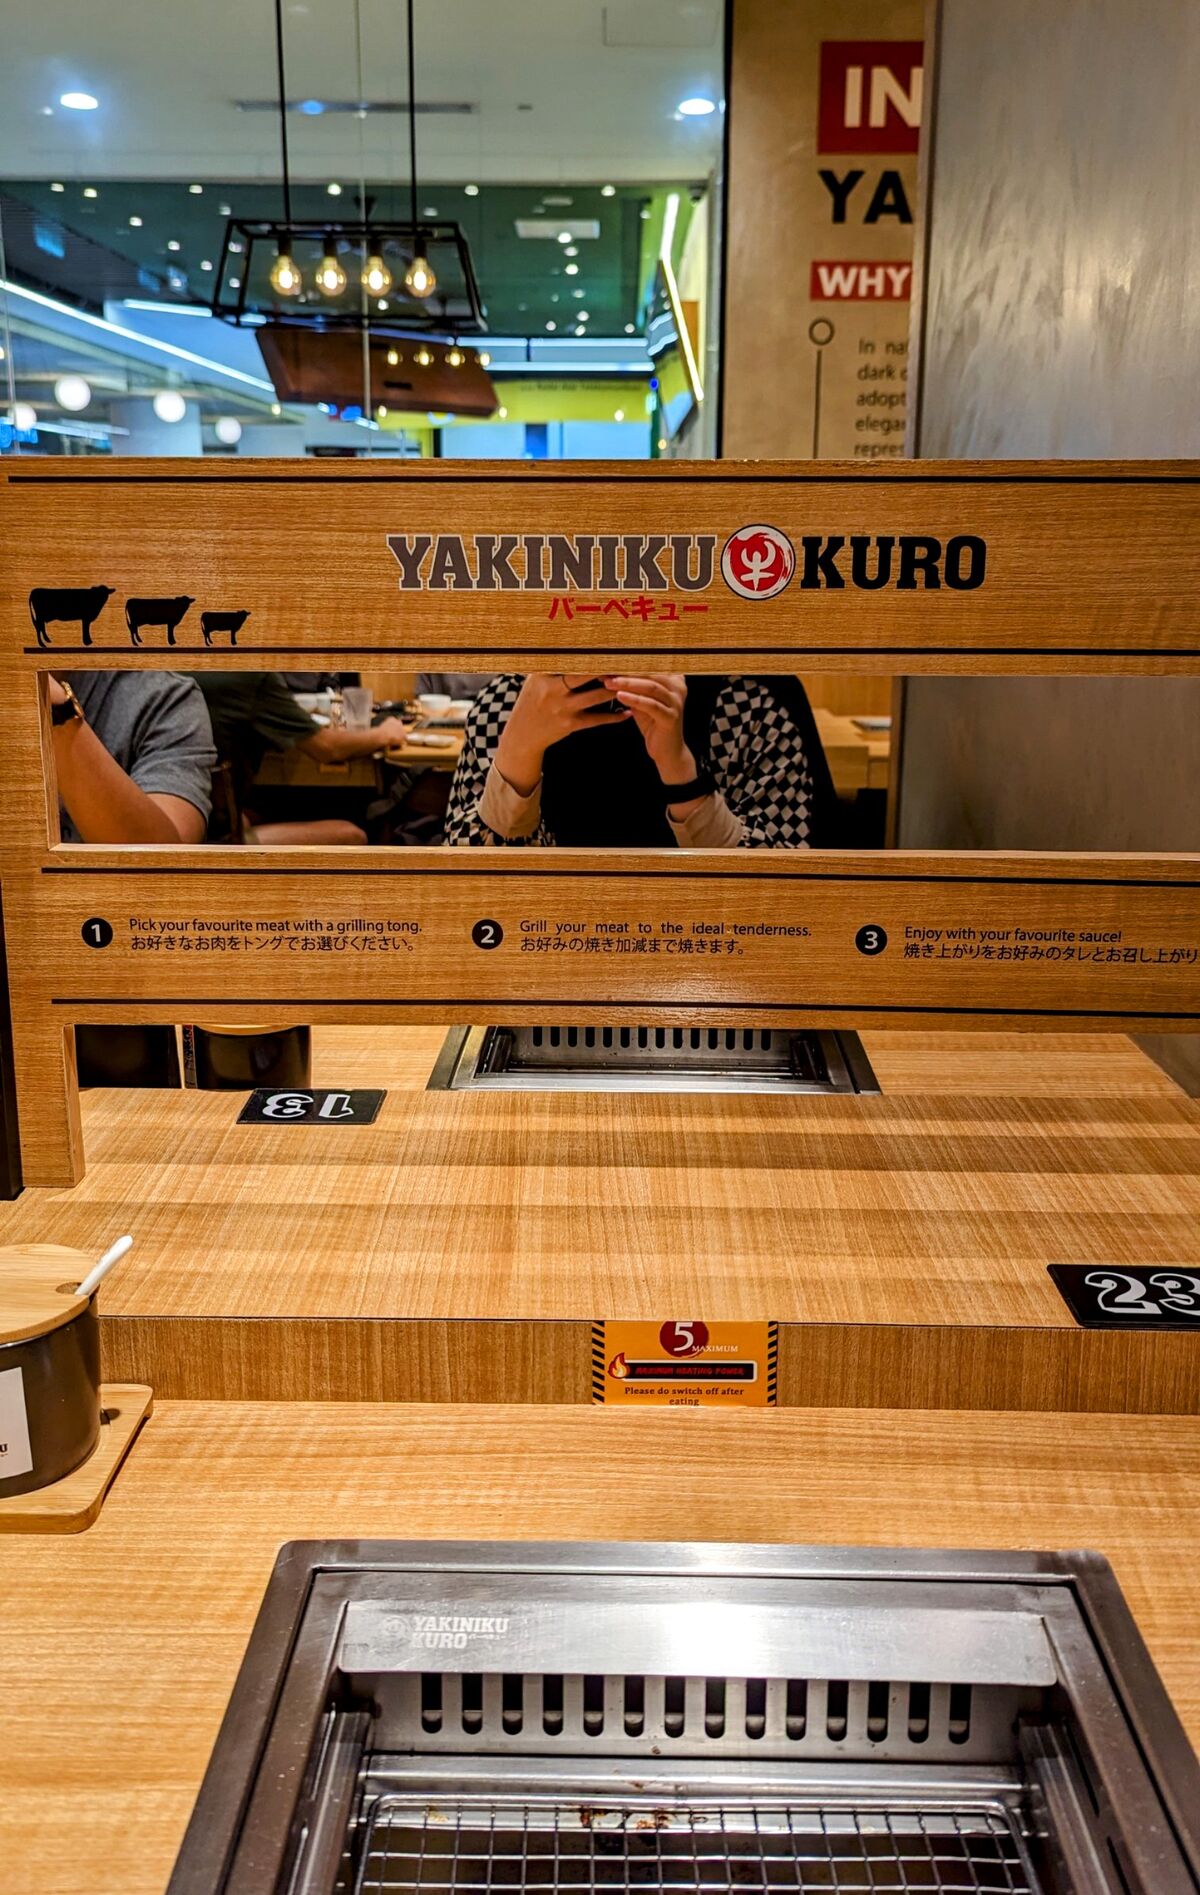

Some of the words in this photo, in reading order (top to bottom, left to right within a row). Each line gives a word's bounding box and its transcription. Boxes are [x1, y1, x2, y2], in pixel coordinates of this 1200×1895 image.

[818, 169, 914, 225] YA
[818, 266, 911, 298] WHY
[858, 338, 875, 355] In
[857, 363, 896, 381] dark
[386, 534, 718, 592] YAKINIKU
[801, 535, 987, 590] KURO
[547, 596, 709, 622] バーベキュー
[129, 918, 157, 931] Pick
[159, 920, 191, 934] your
[192, 918, 253, 931] favourite
[256, 920, 290, 932] meat
[293, 919, 323, 932] with
[326, 922, 334, 932] a
[337, 919, 384, 934] grilling
[387, 920, 422, 934] tong.
[519, 919, 547, 932] Grill
[556, 921, 587, 935] your
[595, 922, 629, 934] meat
[638, 922, 652, 934] to
[661, 922, 683, 934] the
[692, 922, 724, 934] ideal
[733, 923, 812, 936] tenderness.
[905, 926, 943, 942] Enjoy
[945, 927, 976, 940] with
[980, 930, 1011, 943] your
[1014, 928, 1075, 943] favourite
[1078, 930, 1122, 943] sauce!
[131, 934, 414, 951] お好きなお肉をトングでお選びください。
[520, 936, 744, 955] お好みの焼き加減まで焼きます。
[1084, 1271, 1200, 1317] 23
[673, 1321, 694, 1352] 5
[691, 1345, 738, 1353] MAXIMUM
[624, 1387, 655, 1396] Please
[657, 1387, 670, 1396] do
[672, 1387, 703, 1396] switch
[706, 1387, 719, 1396] off
[721, 1387, 745, 1396] after
[669, 1397, 700, 1407] eating
[413, 1615, 510, 1633] YAKINIKU
[411, 1632, 468, 1649] KURO
